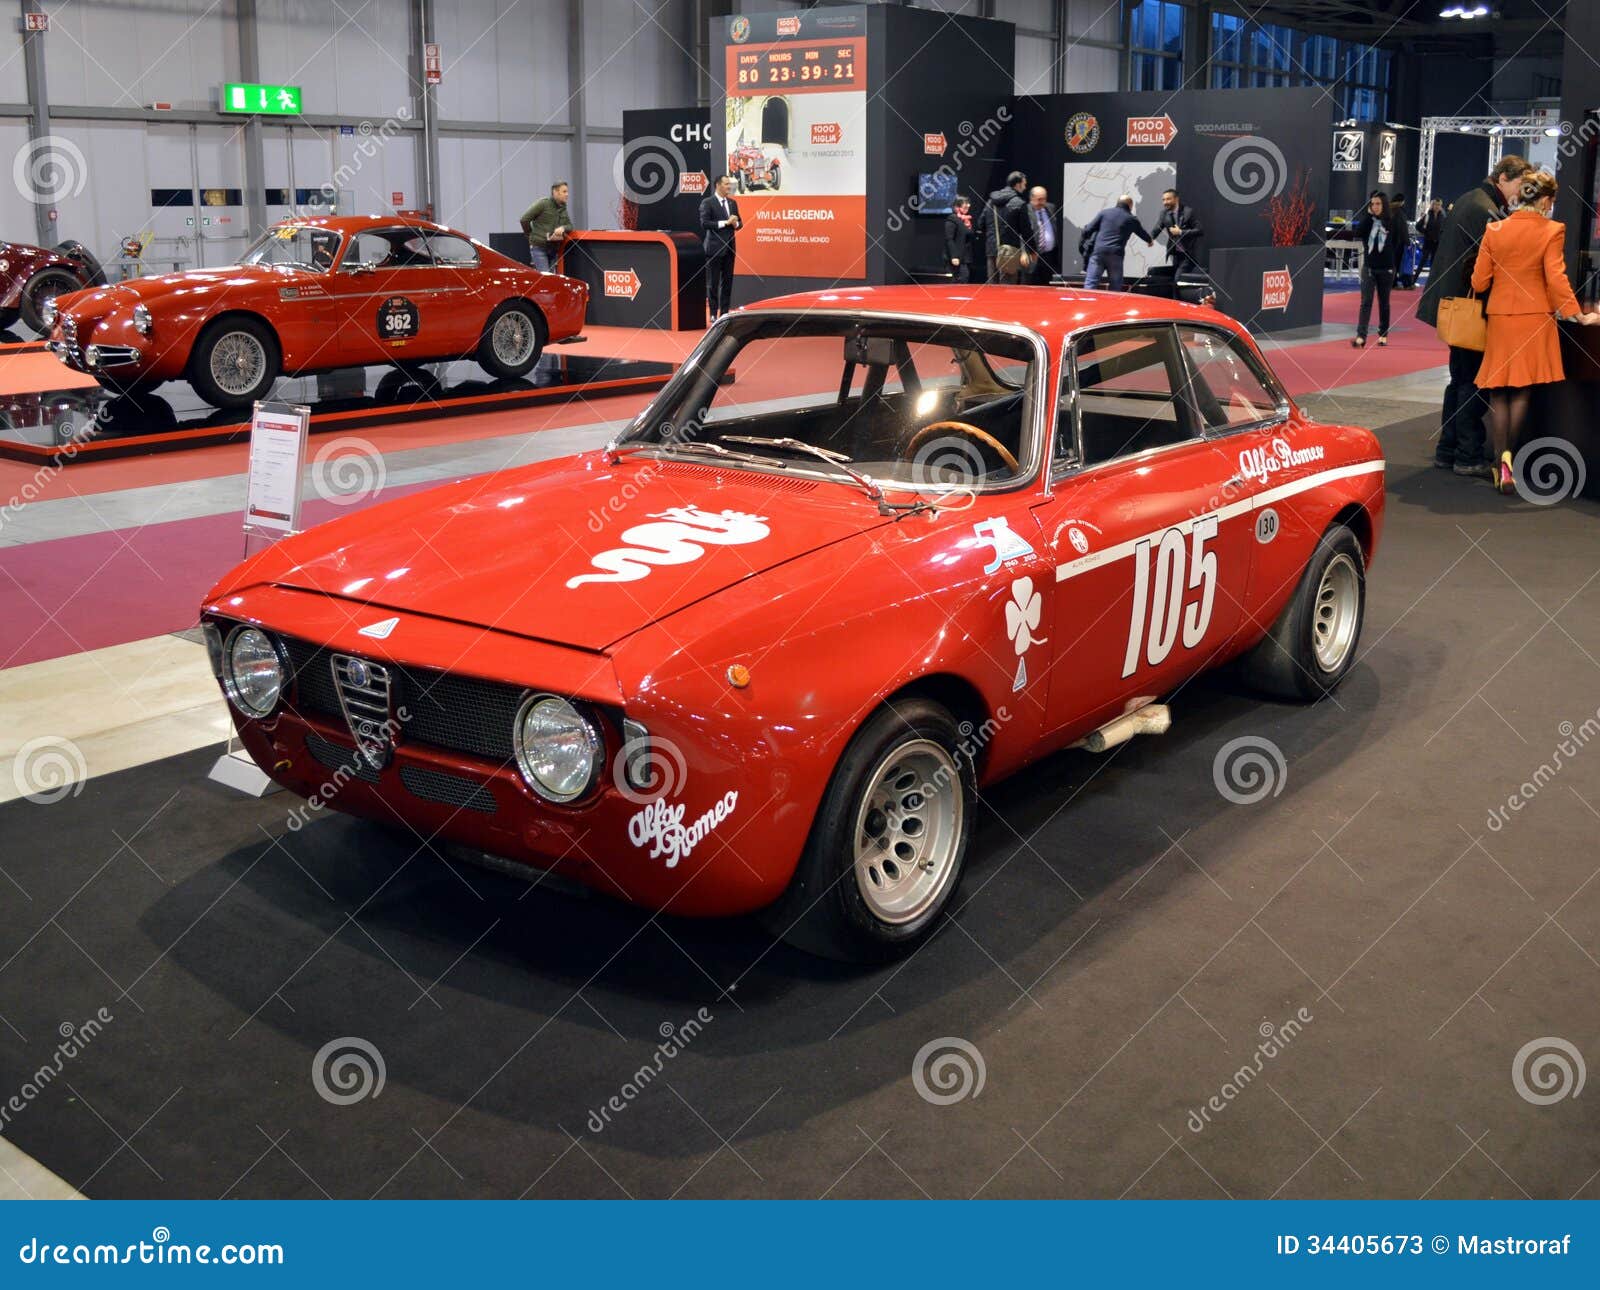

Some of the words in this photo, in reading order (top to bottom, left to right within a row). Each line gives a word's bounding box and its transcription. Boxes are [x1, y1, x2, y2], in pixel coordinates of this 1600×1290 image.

[740, 55, 758, 64] DAYS
[769, 53, 792, 62] HOURS
[805, 51, 819, 60] MIN
[838, 49, 852, 58] SEC
[739, 69, 759, 83] 80
[834, 63, 854, 78] 21
[1133, 120, 1164, 130] 1000
[812, 134, 837, 143] MIGLIA
[1130, 132, 1165, 143] MIGLIA
[771, 211, 781, 220] LA
[782, 209, 834, 220] LEGGENDA
[607, 274, 631, 283] 1000
[1266, 275, 1285, 288] 1000
[607, 284, 633, 294] MIGLIA
[1264, 290, 1286, 304] MIGLIA
[385, 313, 411, 330] 362
[1239, 446, 1280, 484] Alfa
[1272, 438, 1324, 468] Romeo
[1259, 515, 1276, 537] 130
[1121, 514, 1219, 679] 105
[628, 797, 686, 859] Alfa
[661, 790, 739, 868] Romeo
